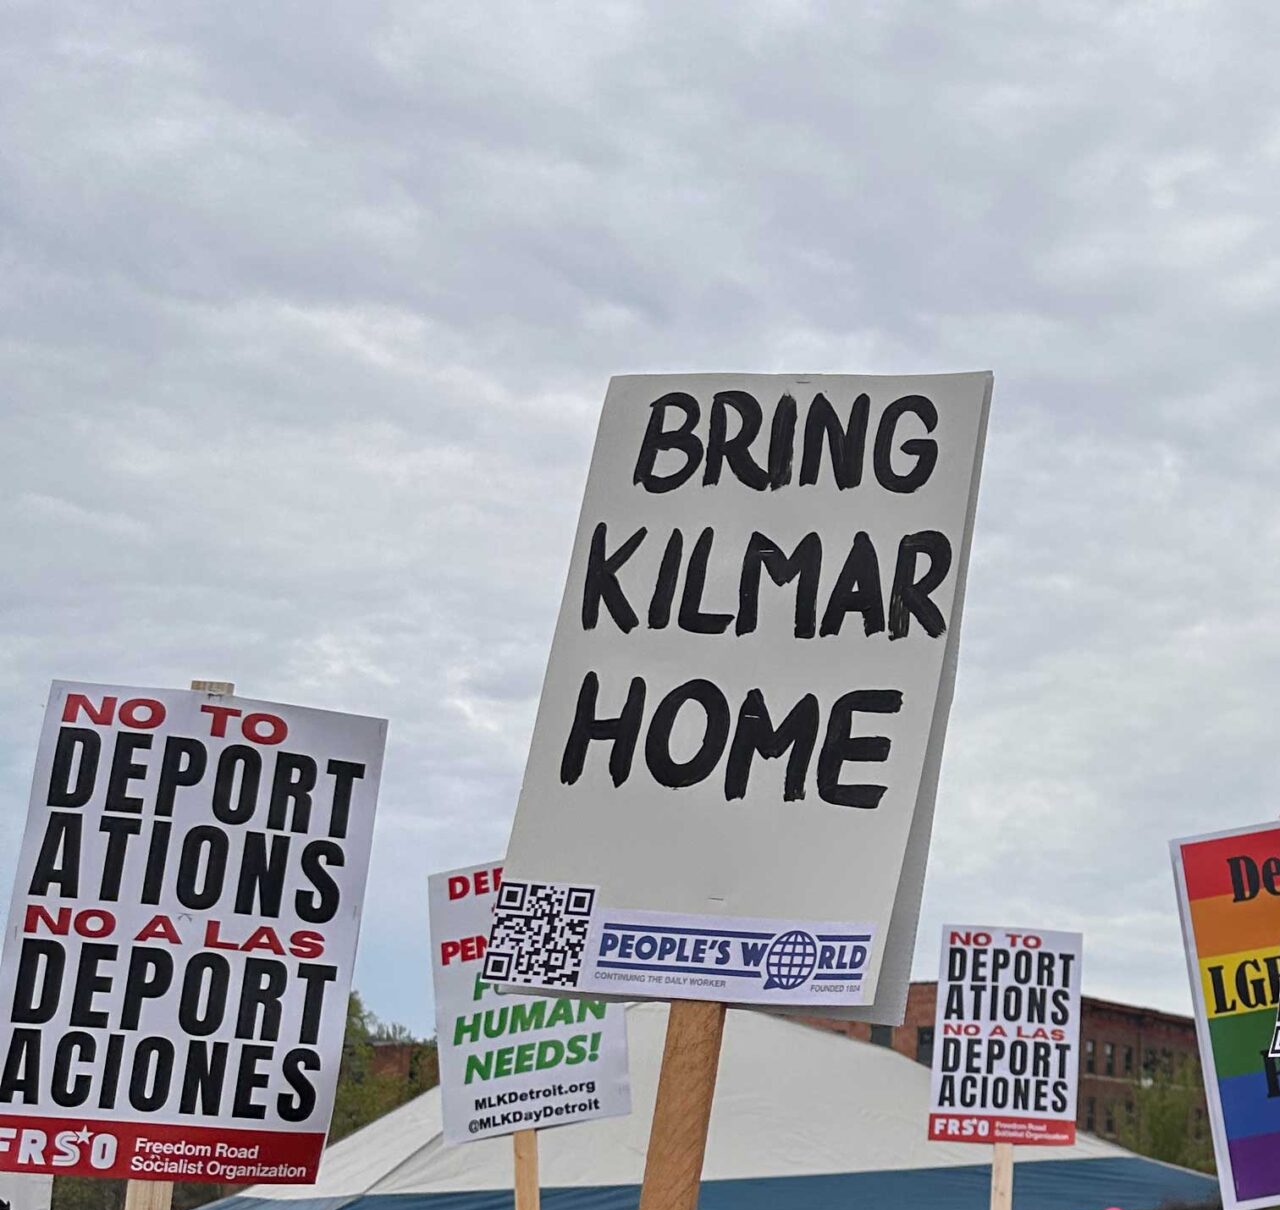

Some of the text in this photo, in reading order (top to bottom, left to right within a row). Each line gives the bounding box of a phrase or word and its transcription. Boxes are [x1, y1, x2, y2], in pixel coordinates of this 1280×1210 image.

[633, 390, 940, 494] BRING
[582, 521, 953, 641] KILMAR
[62, 693, 288, 746] NO TO
[560, 670, 904, 810] HOME
[46, 726, 365, 839] DEPORT
[28, 811, 345, 925] ATIONS
[23, 904, 325, 958] NO A LAS
[599, 932, 731, 967] PEOPLE'S
[949, 931, 1042, 949] NO TO
[594, 971, 726, 988] CONTINUING THE DAILY WORKER
[947, 947, 1075, 988] DEPORT
[10, 937, 338, 1045] DEPORT
[944, 984, 1071, 1026] ATIONS
[453, 1000, 607, 1046] HUMAN
[943, 1024, 1065, 1041] NO A LAS
[0, 1027, 322, 1123] ACIONES
[464, 1032, 602, 1085] NEEDS!
[941, 1038, 1071, 1079] DEPORT
[474, 1080, 596, 1111] MLKDetroit.org
[938, 1075, 1068, 1113] ACIONES
[468, 1099, 600, 1134] @MLKDayDetroit
[131, 1156, 306, 1180] Socialist Organization
[135, 1137, 211, 1157] Freedom
[215, 1143, 259, 1159] Road
